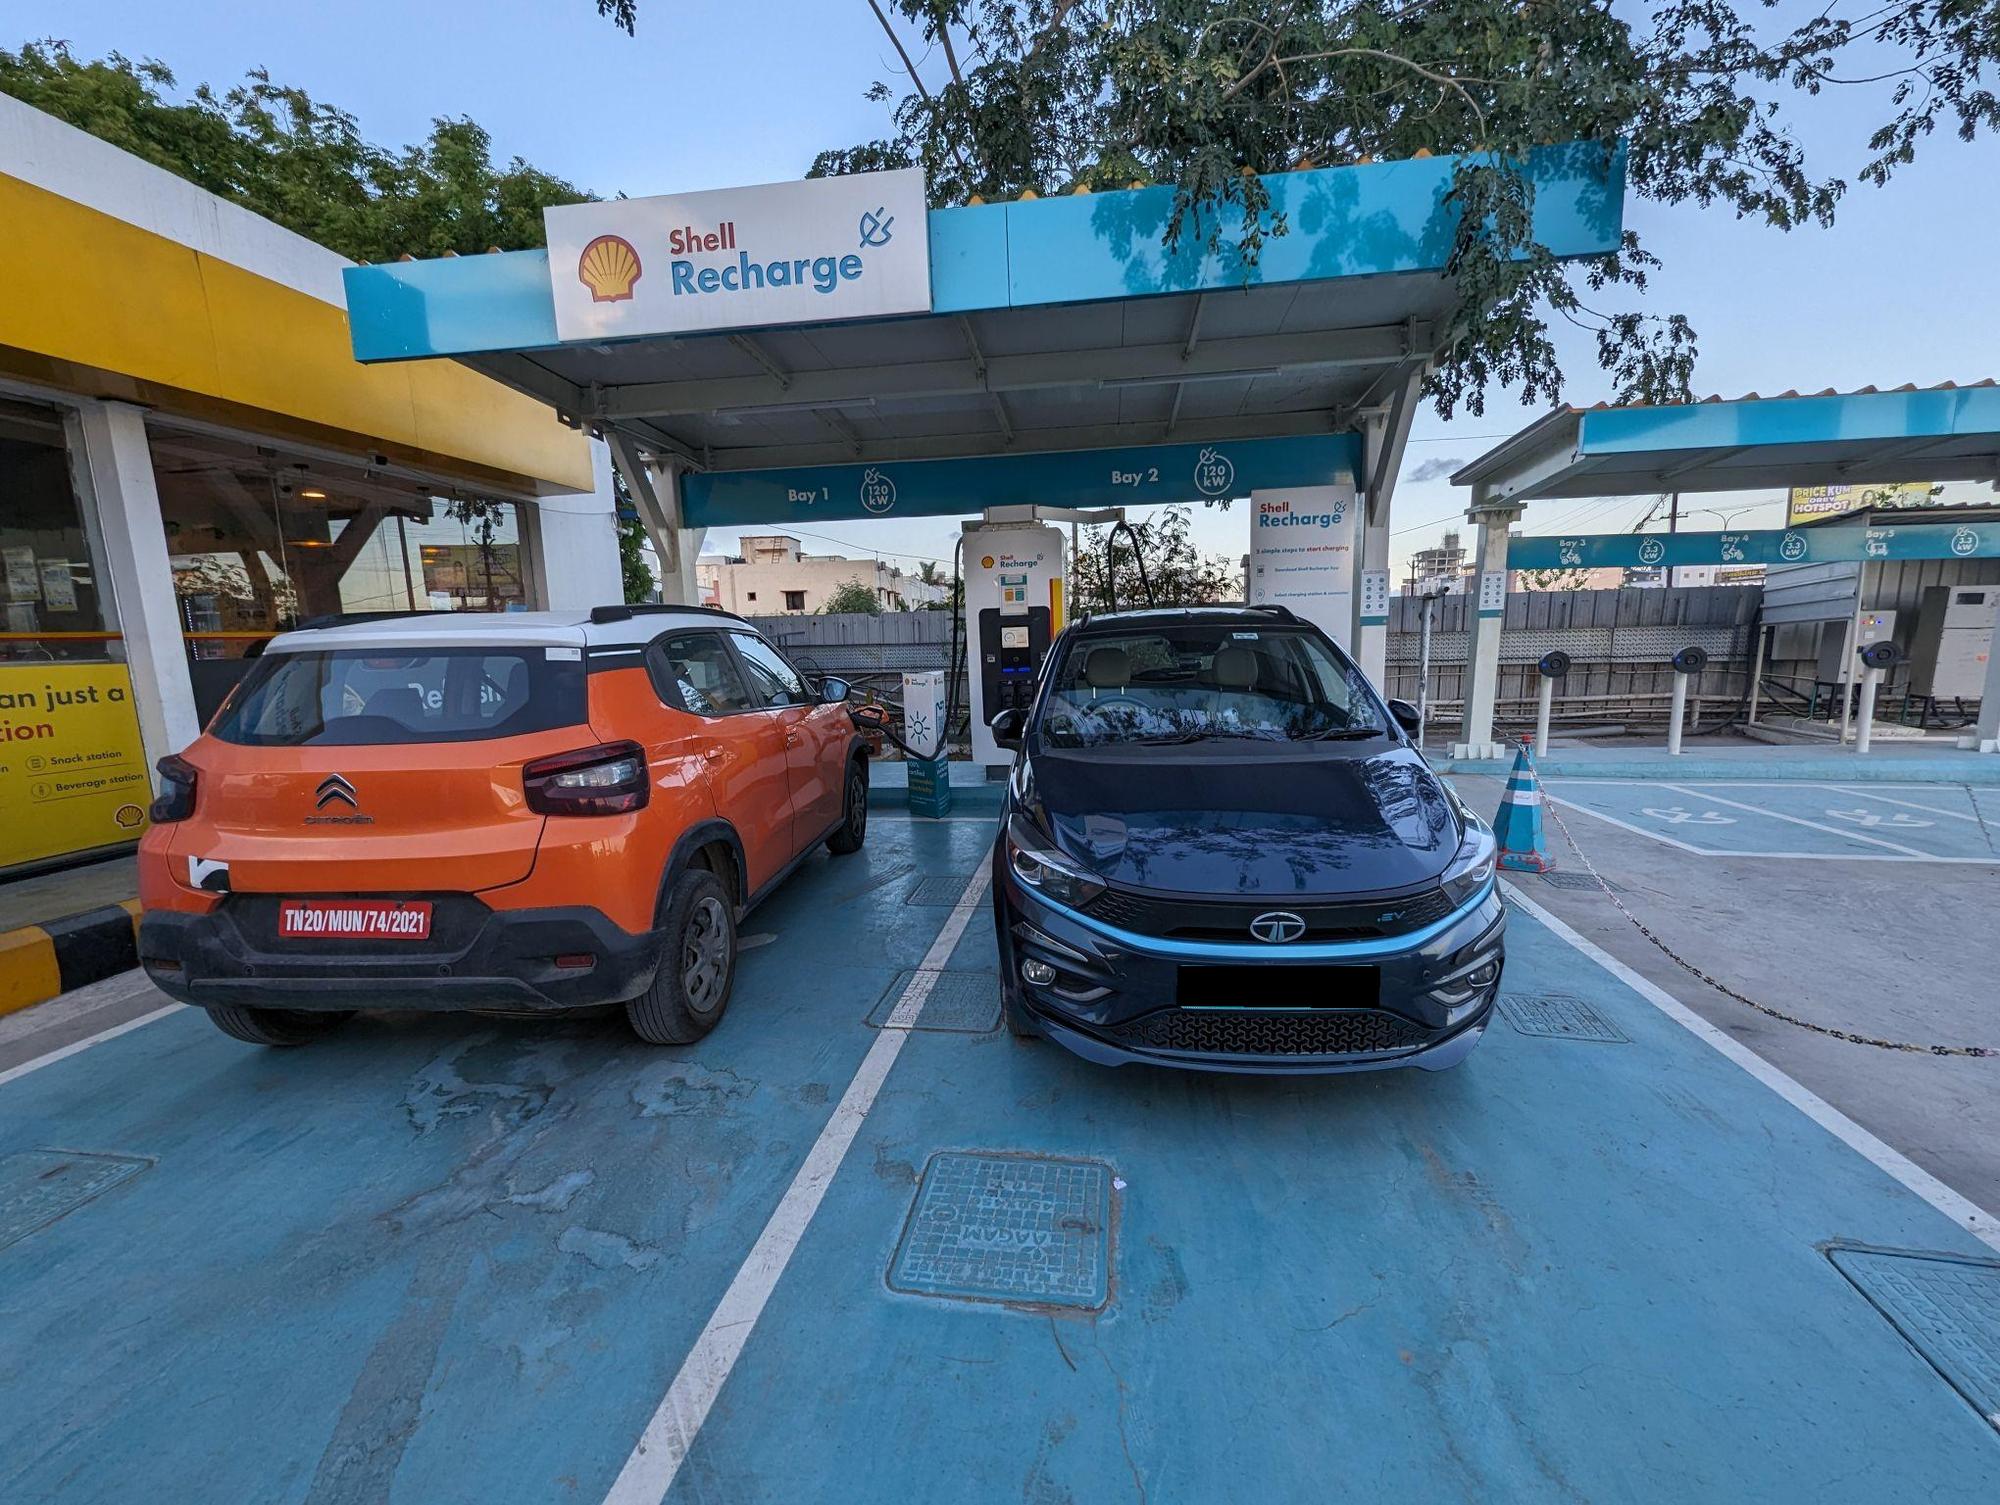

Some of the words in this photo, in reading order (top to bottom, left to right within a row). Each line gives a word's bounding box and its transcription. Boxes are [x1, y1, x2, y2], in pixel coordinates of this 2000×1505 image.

[669, 222, 736, 255] Shell
[671, 250, 863, 296] Recharge
[1203, 465, 1226, 476] 120
[1111, 470, 1142, 487] Bay
[1147, 467, 1159, 482] 2
[1203, 476, 1225, 487] kW
[868, 485, 888, 495] 120
[1795, 486, 1828, 497] PRICE
[788, 488, 816, 505] Bay
[822, 487, 829, 500] 1
[868, 495, 888, 505] kW
[1260, 502, 1289, 513] Shell
[1794, 500, 1850, 513] HOTSPOT
[1259, 511, 1342, 528] Recharge
[1721, 534, 1740, 543] Bay
[1865, 530, 1887, 539] Bay
[1888, 529, 1895, 538] 5
[1560, 539, 1577, 547] Bay
[1580, 538, 1586, 546] 3
[1957, 543, 1972, 551] kW
[1000, 559, 1038, 568] Recharge
[45, 685, 99, 712] just
[107, 687, 125, 701] a
[50, 753, 83, 766] Snack
[86, 750, 122, 761] station
[56, 777, 107, 792] Beverage
[109, 773, 144, 784] station
[285, 909, 425, 933] TN20/MUN/74/2021
